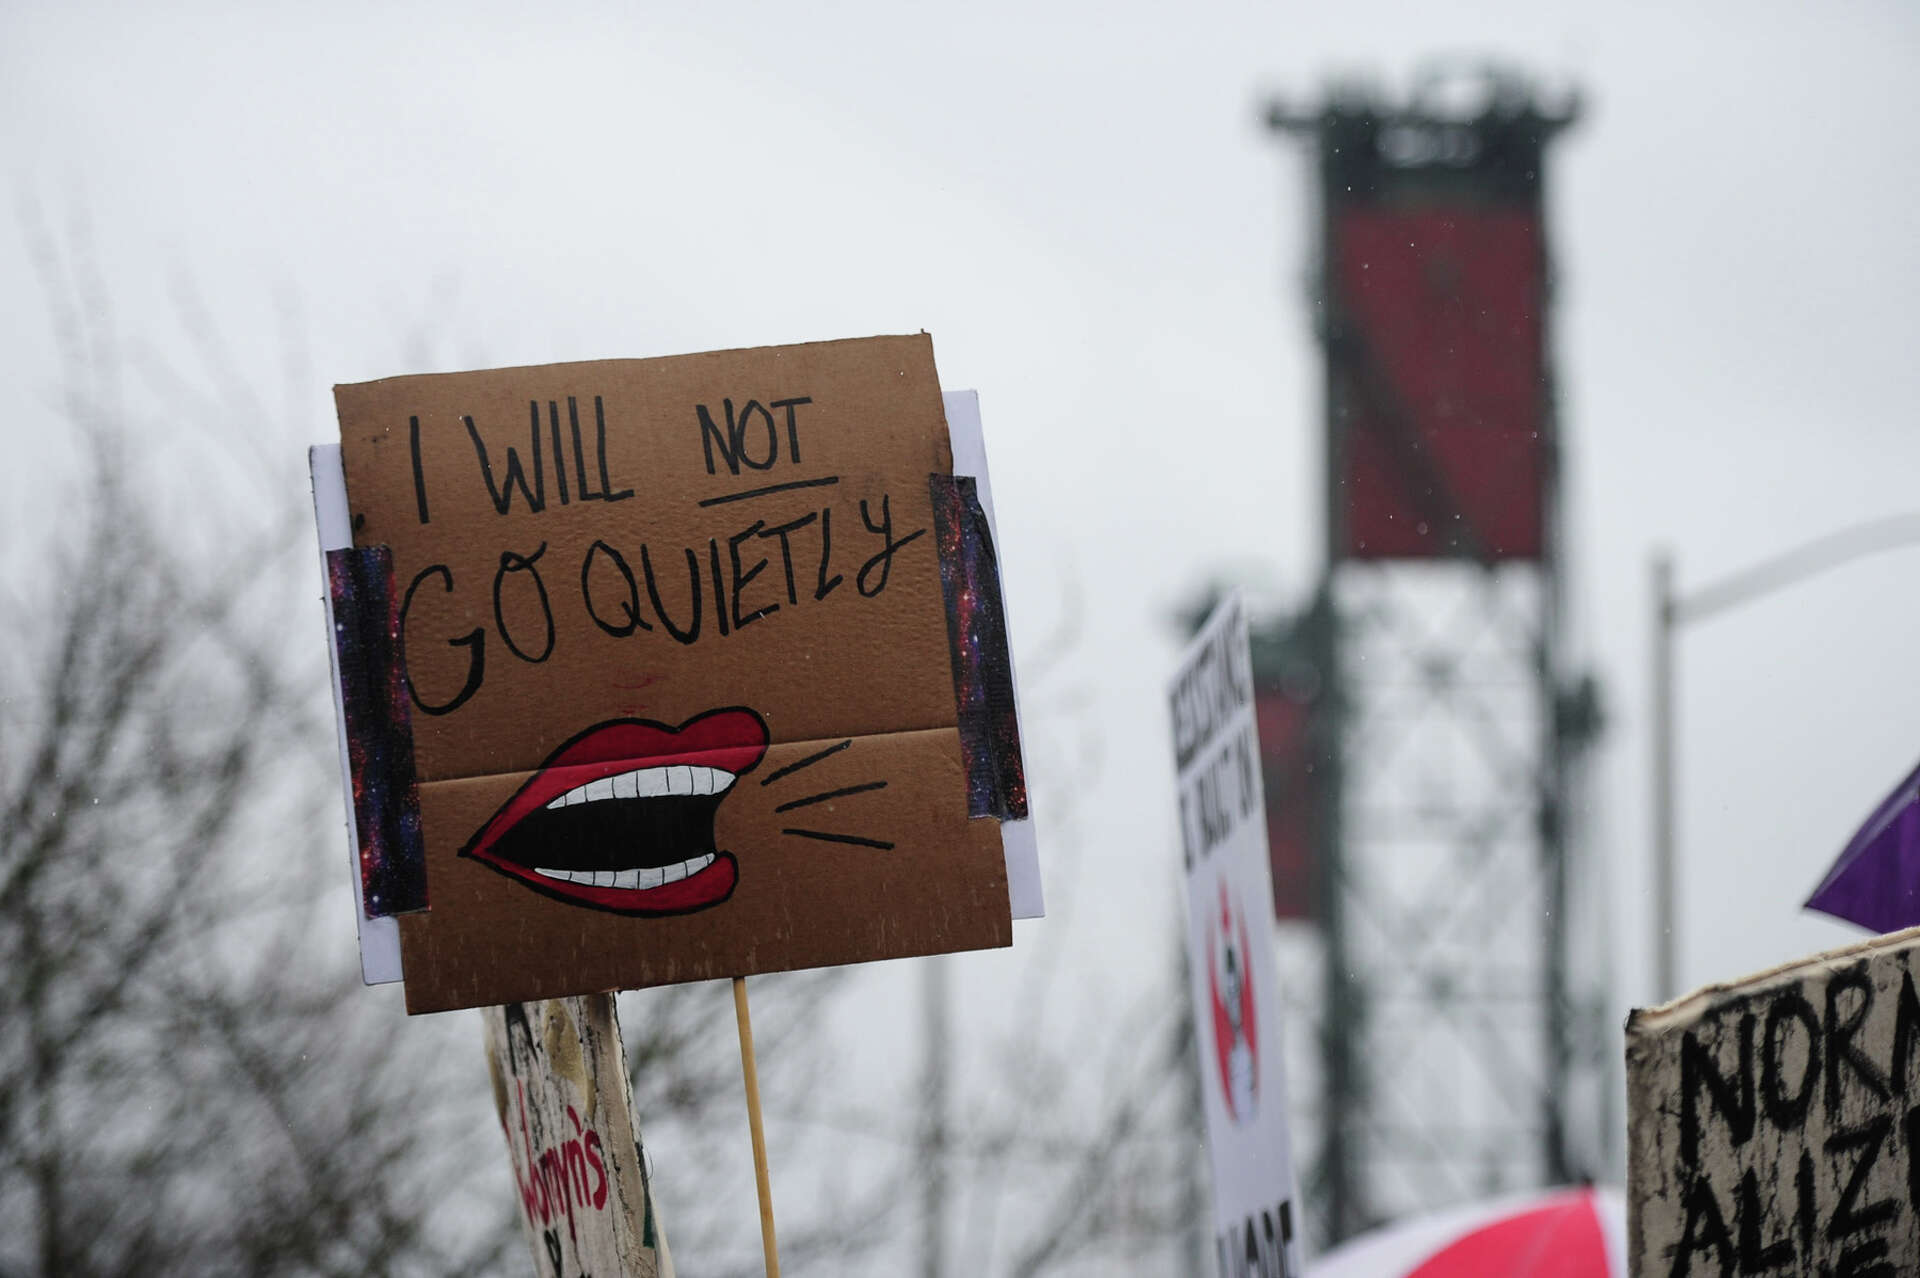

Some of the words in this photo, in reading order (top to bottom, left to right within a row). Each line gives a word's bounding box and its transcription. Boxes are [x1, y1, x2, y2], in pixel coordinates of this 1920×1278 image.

[409, 415, 430, 524] I
[463, 394, 635, 516] WILL
[695, 395, 812, 476] NOT
[399, 540, 556, 717] GO
[580, 493, 927, 646] QUIETLY
[1662, 1105, 1920, 1278] ALIZ
